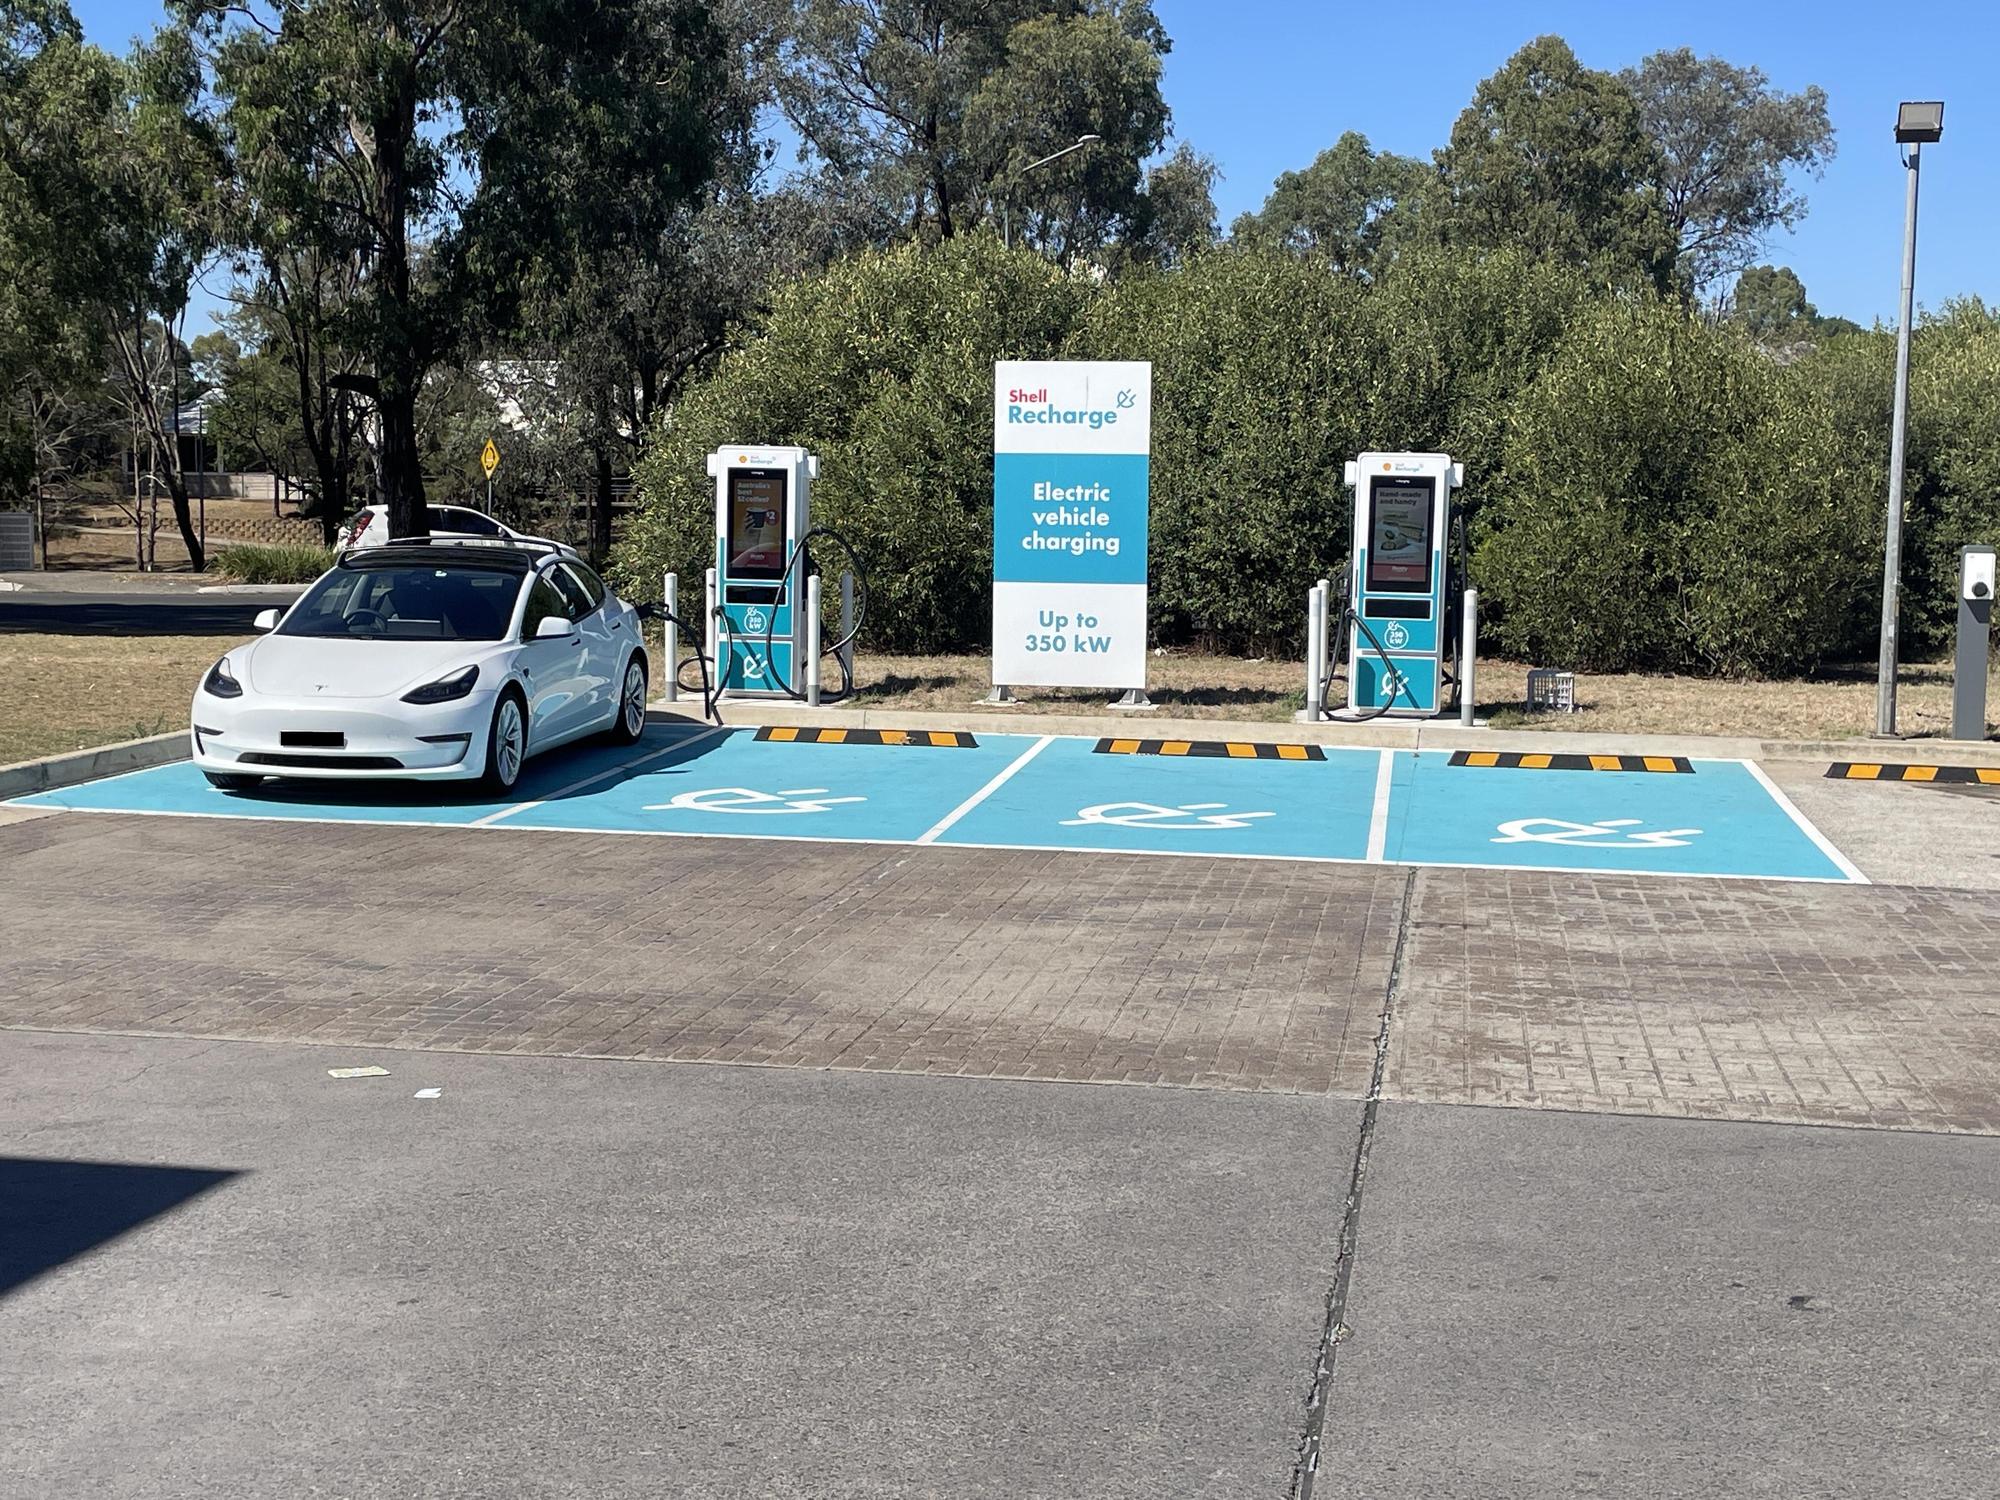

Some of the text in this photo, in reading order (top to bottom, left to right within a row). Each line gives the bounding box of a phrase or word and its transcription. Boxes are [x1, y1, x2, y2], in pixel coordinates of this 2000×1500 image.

[1009, 389, 1047, 403] Shell
[1008, 405, 1118, 429] Recharge
[1033, 483, 1110, 502] Electric
[1032, 506, 1109, 526] vehicle
[1022, 531, 1120, 556] charging
[1039, 610, 1099, 632] Up to
[1025, 635, 1112, 653] 350 kW
